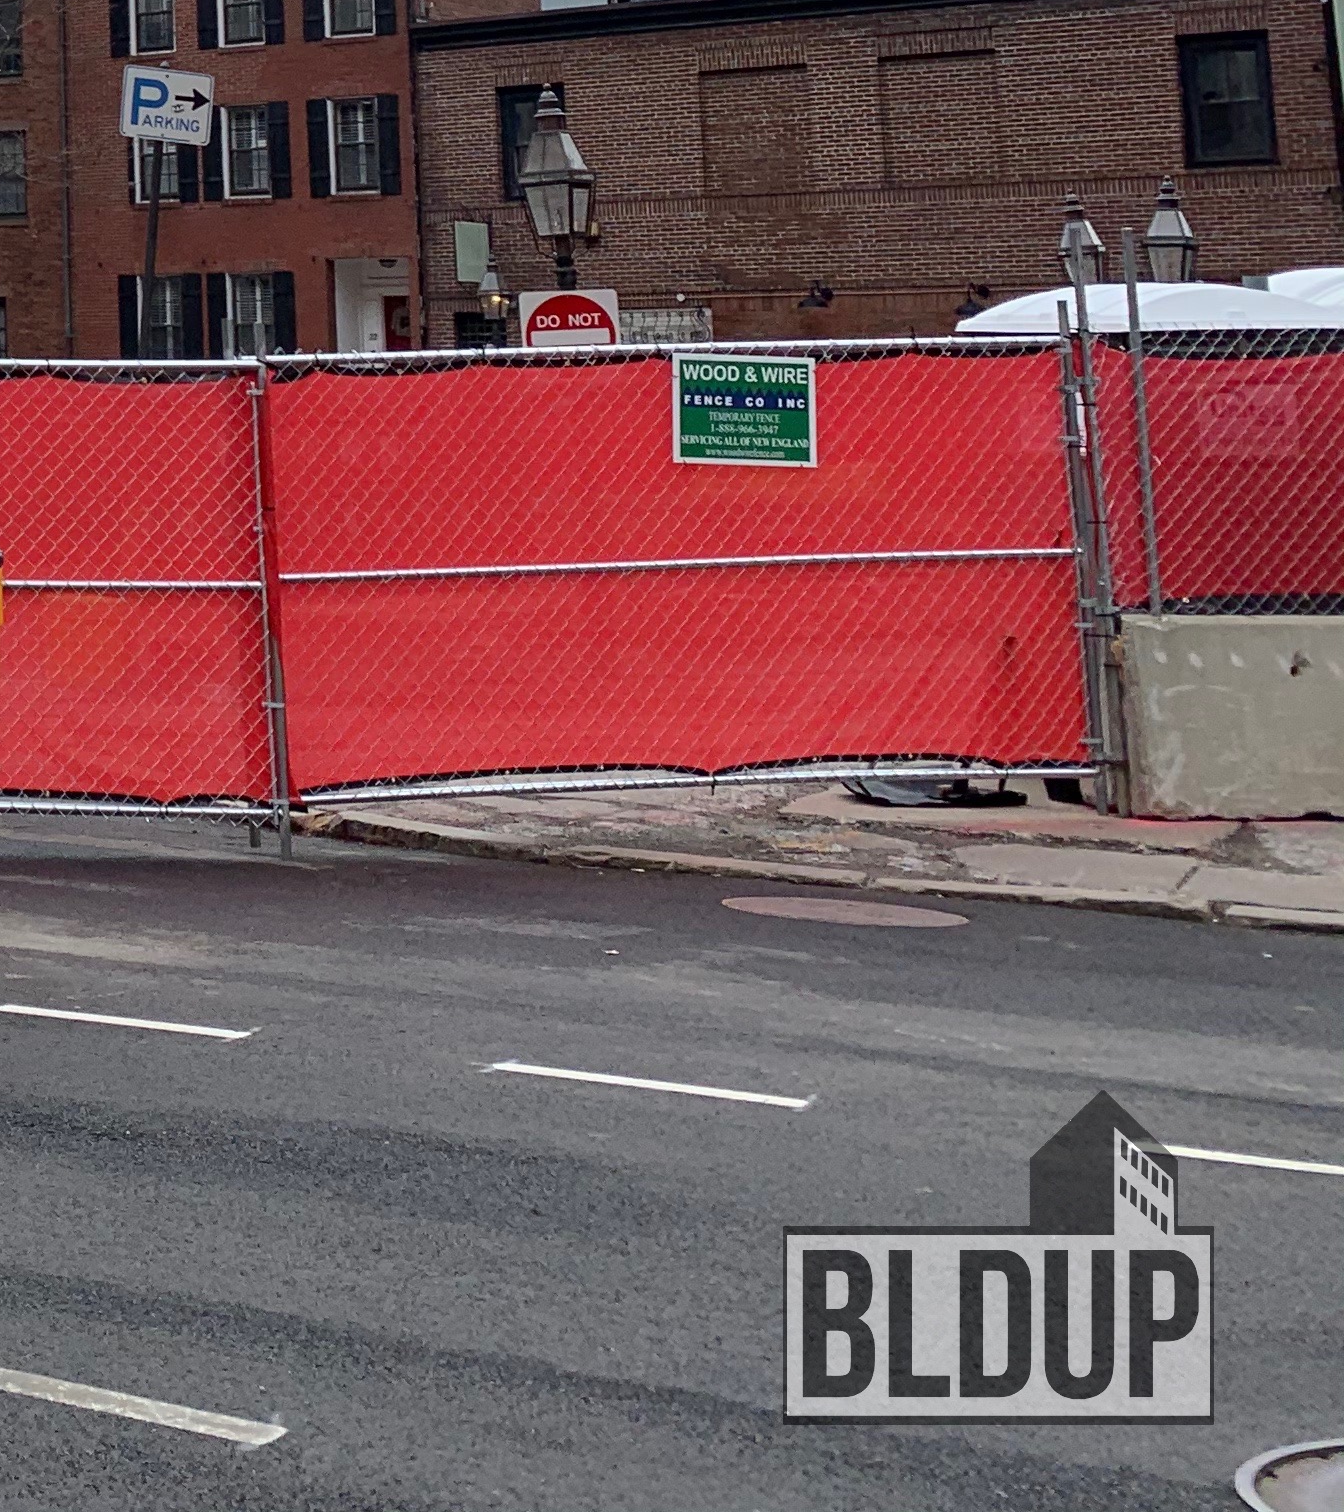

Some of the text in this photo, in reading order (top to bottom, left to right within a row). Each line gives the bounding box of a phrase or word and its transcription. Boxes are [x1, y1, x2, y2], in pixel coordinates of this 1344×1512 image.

[535, 313, 602, 329] DO NOT
[682, 363, 808, 384] WOOD & WIRE
[683, 394, 806, 409] FENCE CO INC
[708, 411, 781, 424] TEMPORARY FENCE
[681, 434, 809, 448] SERVICING ALL OF NEW ENGLAND
